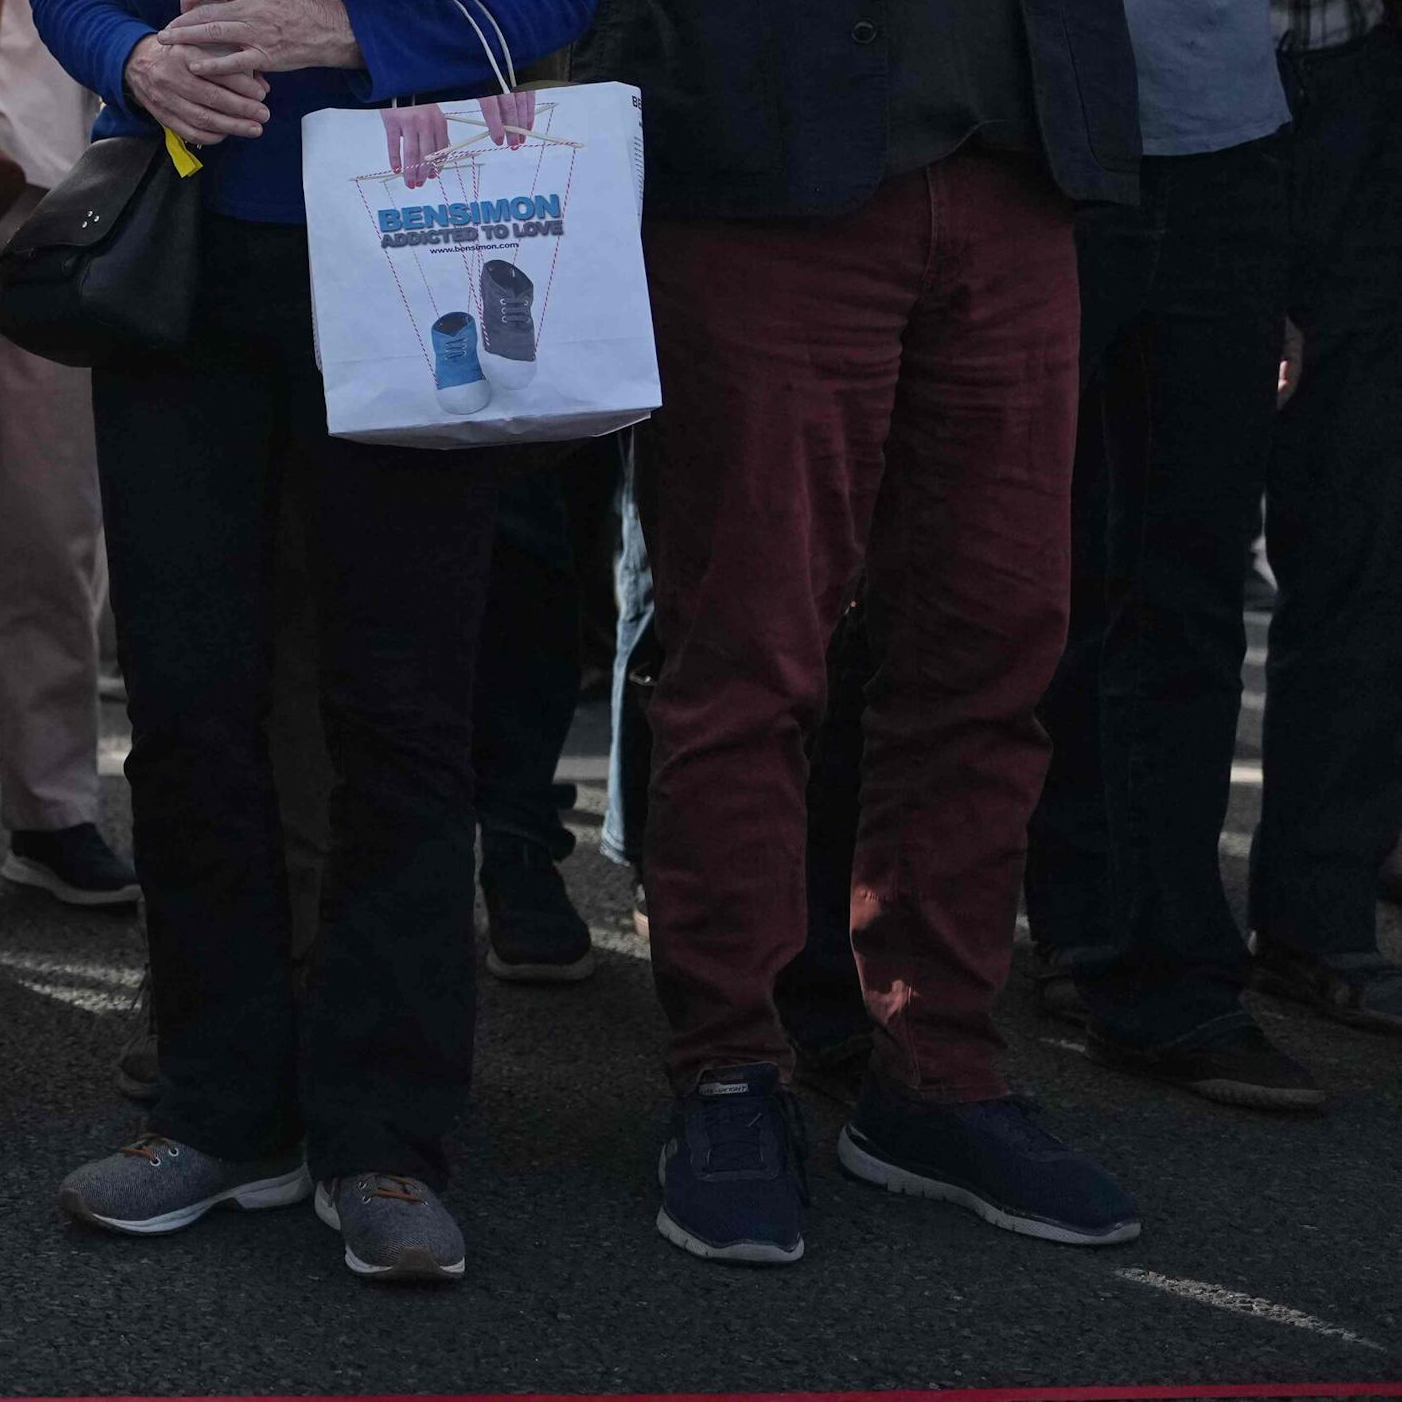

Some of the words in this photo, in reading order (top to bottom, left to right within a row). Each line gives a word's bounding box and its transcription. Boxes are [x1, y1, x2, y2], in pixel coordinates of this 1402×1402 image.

[378, 194, 563, 233] BENSIMON
[381, 226, 479, 249] ADDICTED
[481, 223, 510, 241] TO
[512, 219, 565, 239] LOVE
[429, 241, 520, 255] www.bensimon.com
